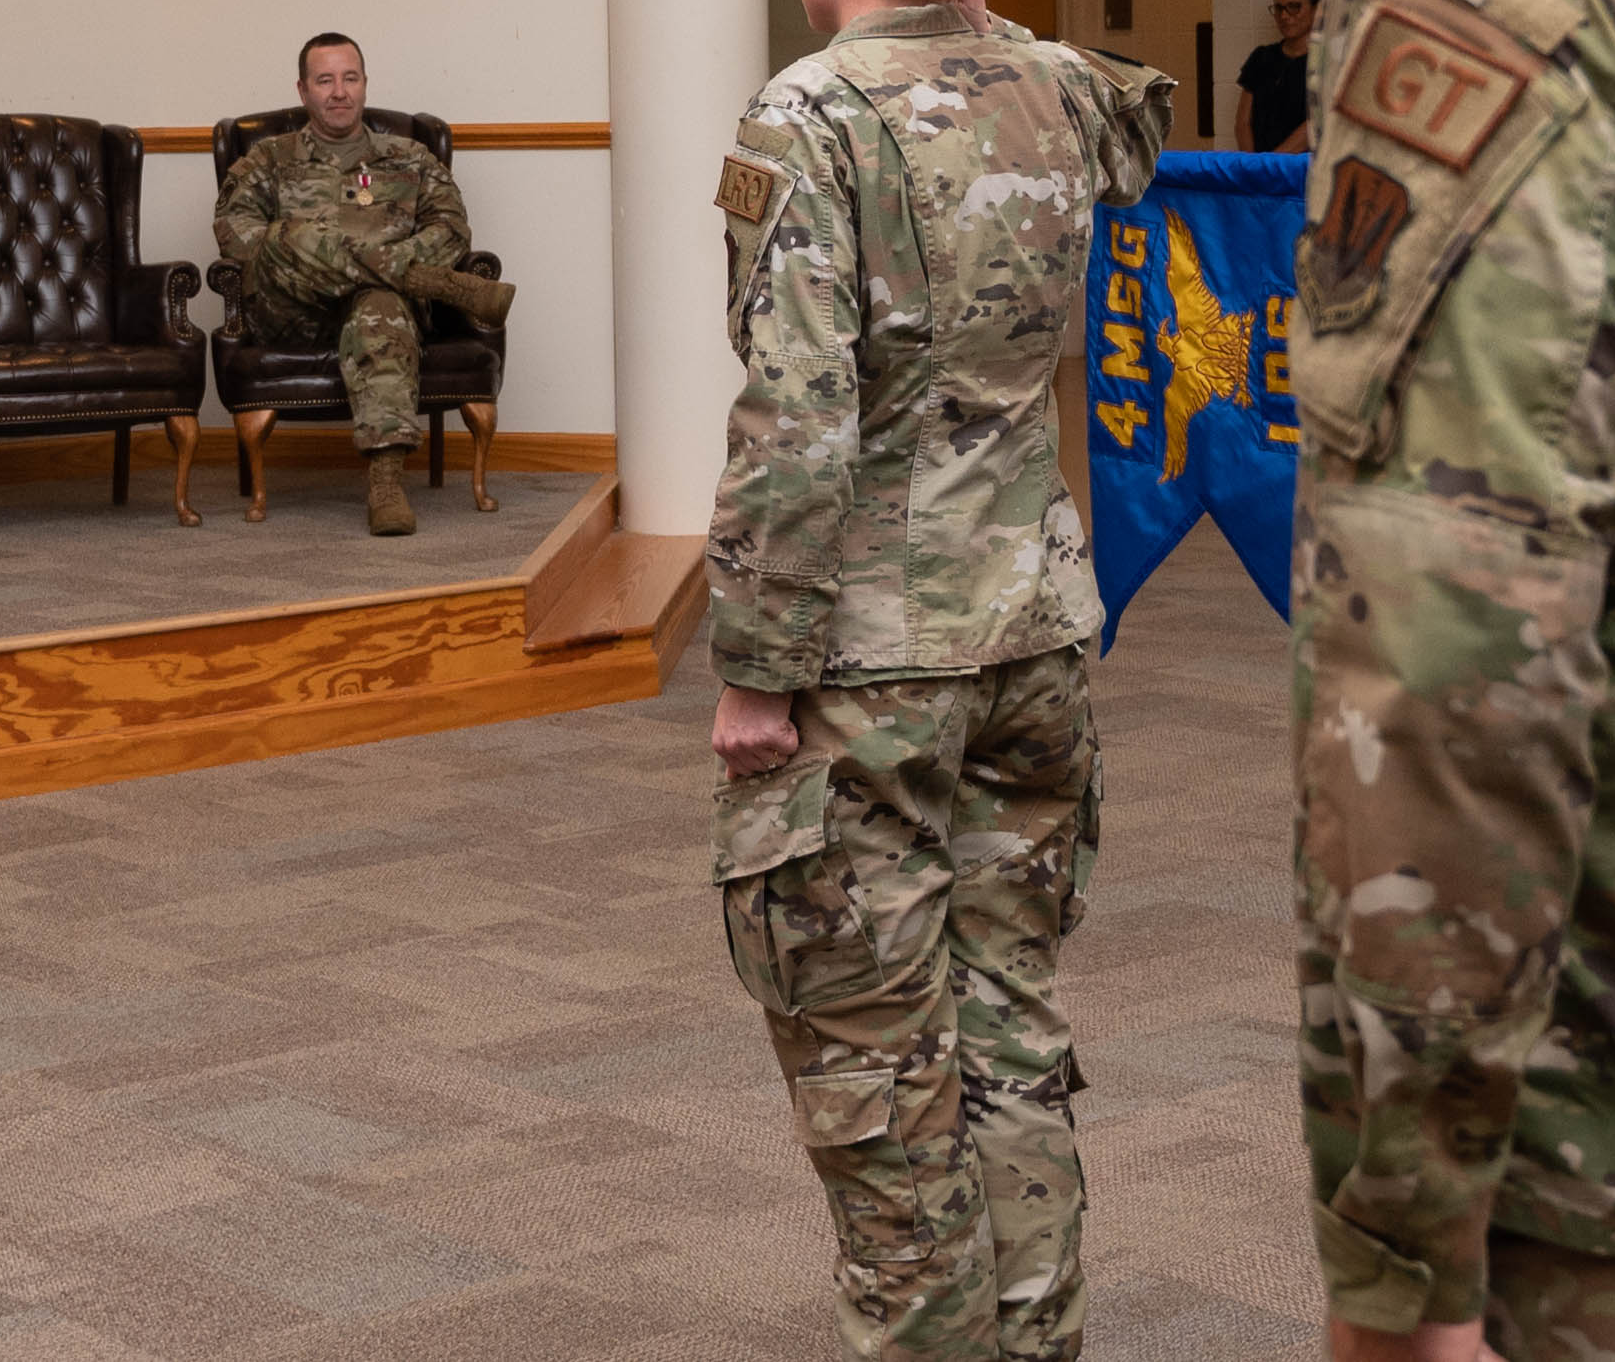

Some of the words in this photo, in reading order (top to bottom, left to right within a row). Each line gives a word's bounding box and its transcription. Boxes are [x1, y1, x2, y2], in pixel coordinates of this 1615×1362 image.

[1375, 42, 1488, 133] GT
[1100, 219, 1150, 383] MSG
[1095, 399, 1149, 449] 4
